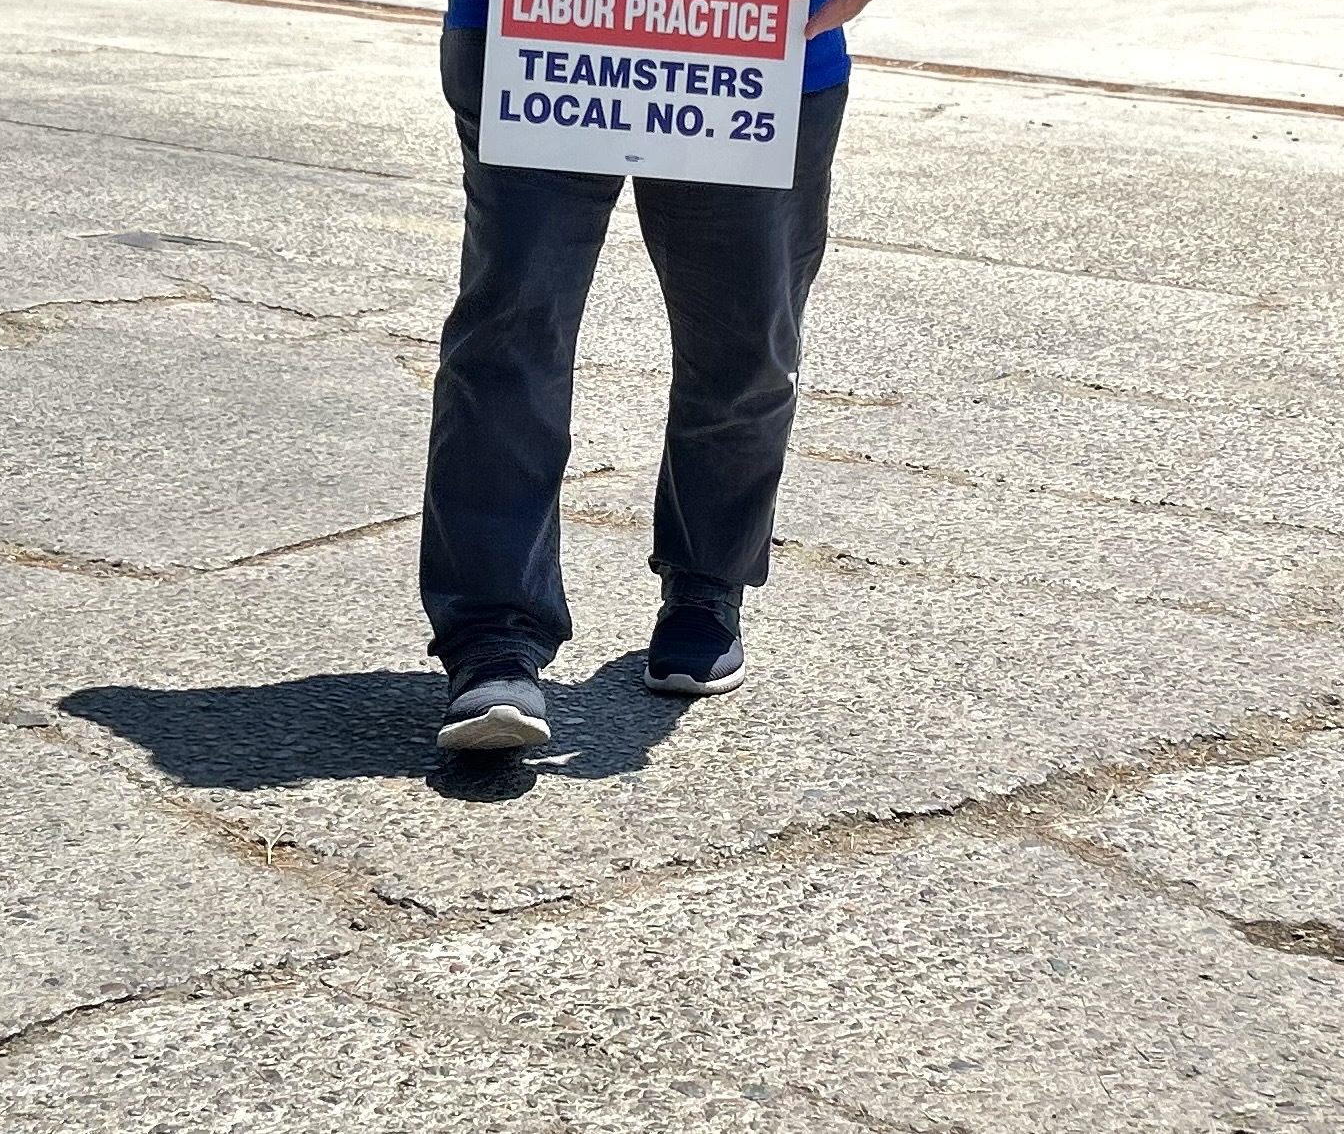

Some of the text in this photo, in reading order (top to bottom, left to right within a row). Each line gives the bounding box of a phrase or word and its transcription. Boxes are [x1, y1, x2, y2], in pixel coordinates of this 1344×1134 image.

[518, 49, 764, 99] TEAMSTERS
[500, 90, 775, 142] LOCAL NO. 25
